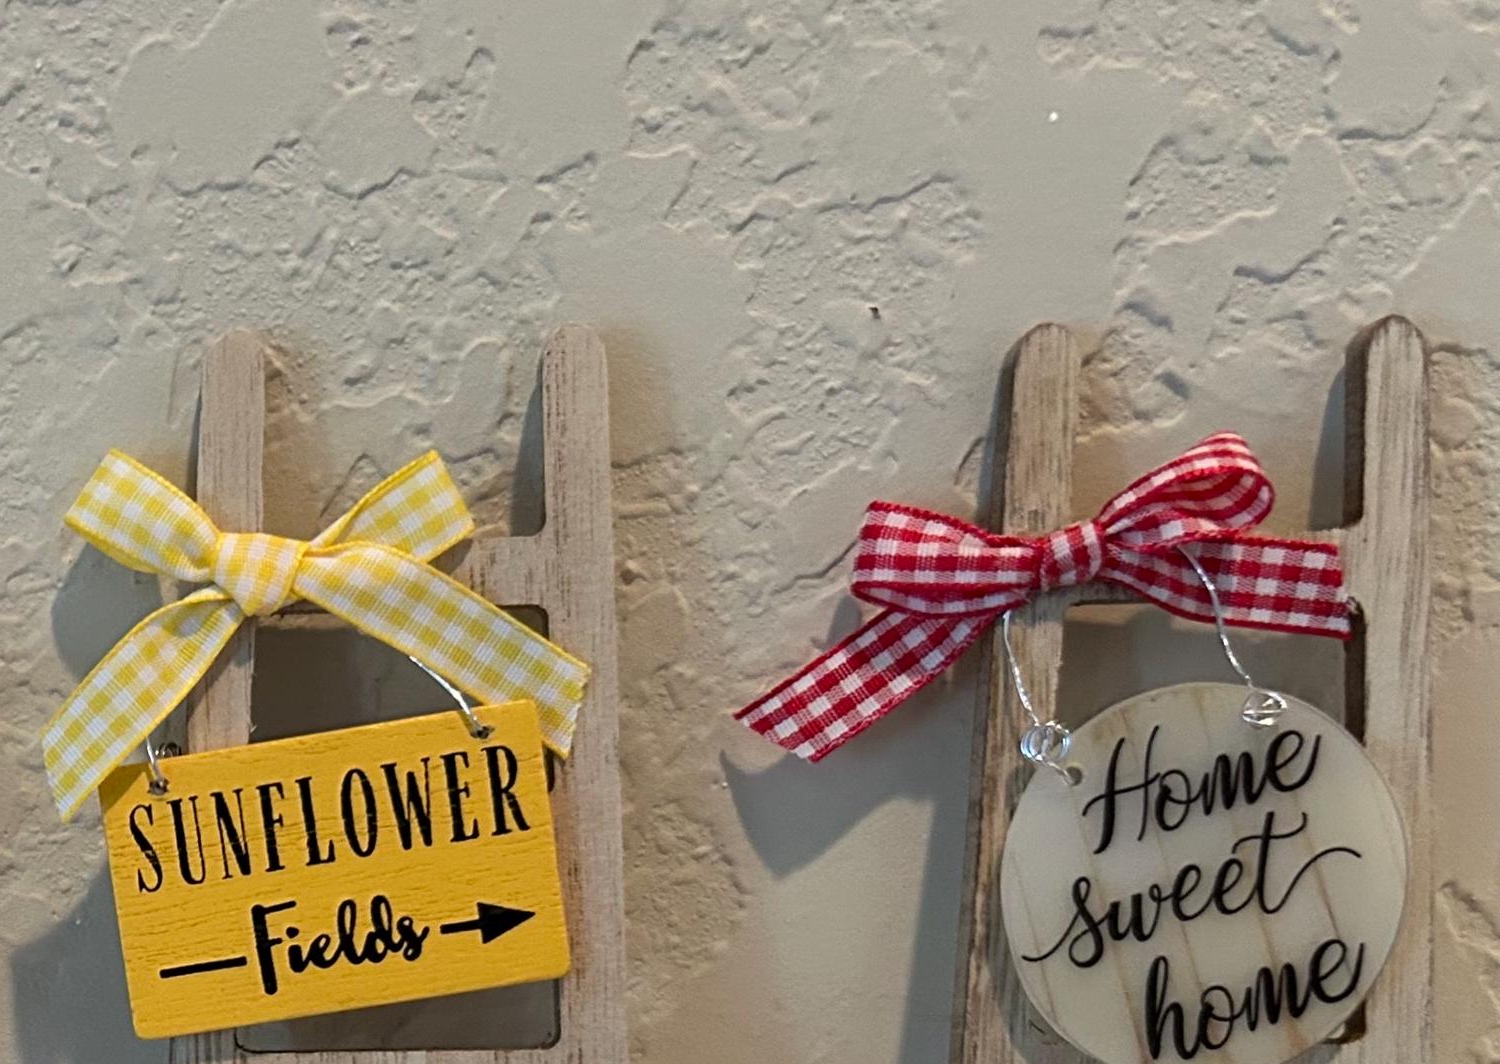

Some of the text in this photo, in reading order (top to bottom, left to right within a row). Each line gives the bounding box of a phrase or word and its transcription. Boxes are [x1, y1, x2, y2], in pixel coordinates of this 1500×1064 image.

[128, 744, 532, 893] SUNFLOWER
[1082, 725, 1322, 855] Home
[250, 895, 430, 996] Fields
[1021, 811, 1362, 968] sweet
[1144, 938, 1365, 1061] home
